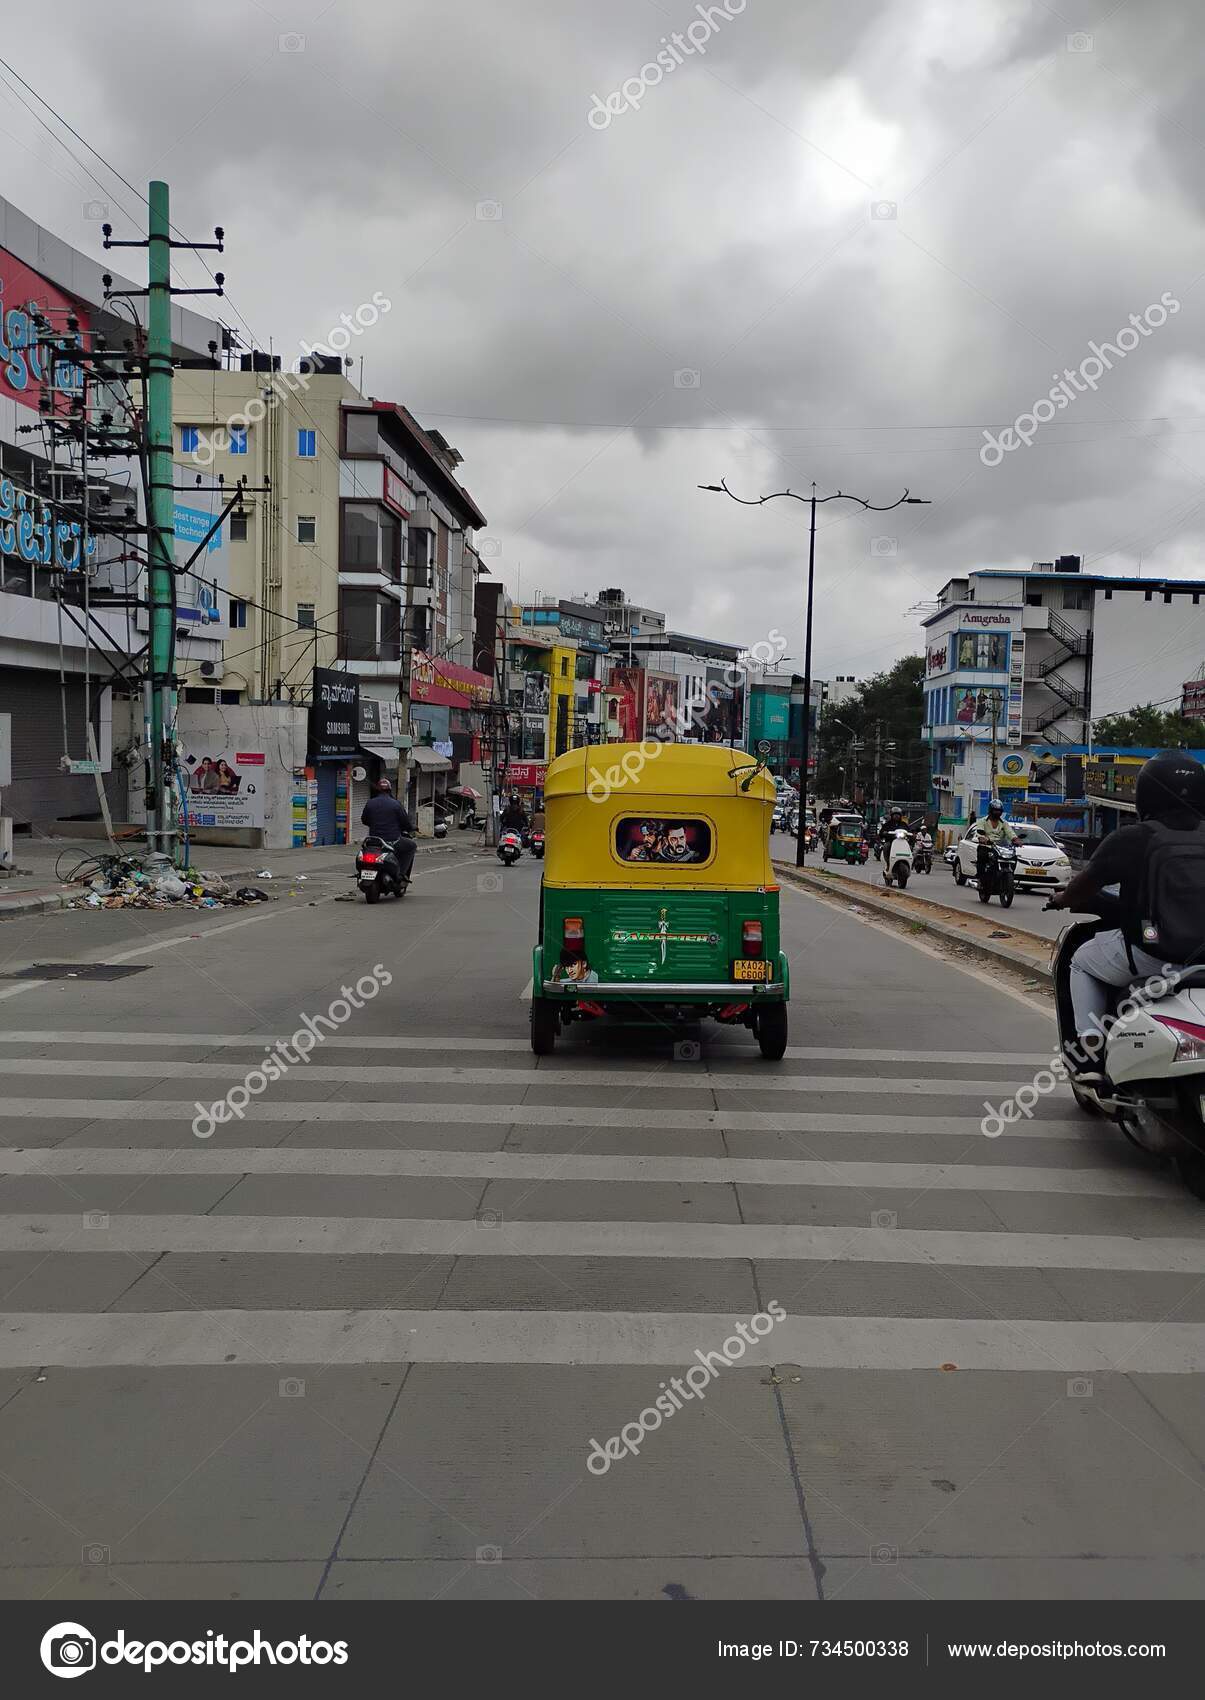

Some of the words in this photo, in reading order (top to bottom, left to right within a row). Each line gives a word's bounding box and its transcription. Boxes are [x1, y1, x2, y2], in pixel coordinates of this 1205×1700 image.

[962, 612, 1011, 626] Anugraha
[326, 721, 351, 735] SAMSUNG
[741, 961, 767, 971] KA02
